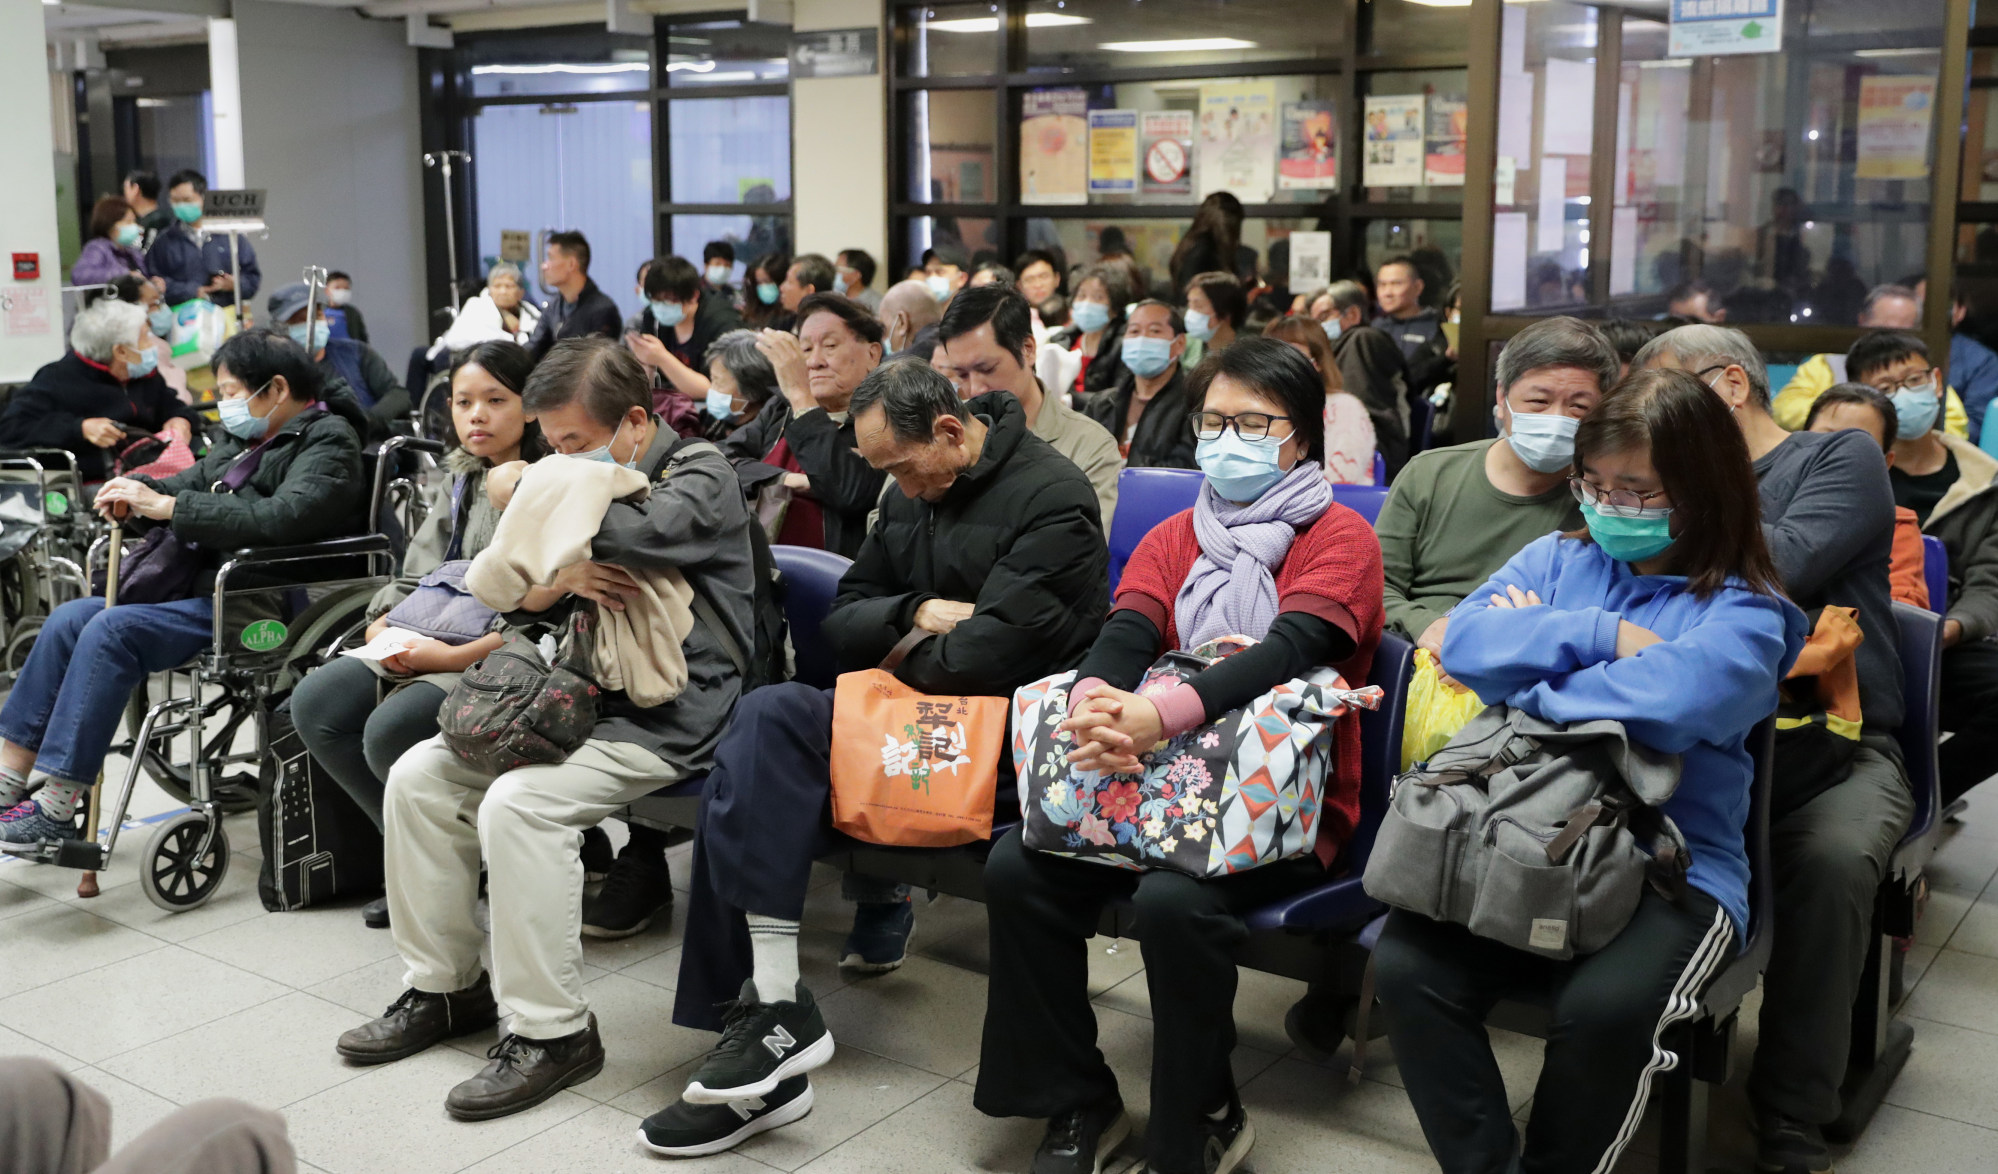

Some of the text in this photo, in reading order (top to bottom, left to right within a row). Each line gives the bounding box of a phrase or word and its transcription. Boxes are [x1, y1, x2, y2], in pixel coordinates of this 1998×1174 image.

[213, 193, 258, 207] UCH
[206, 207, 260, 217] PROPERTY
[246, 630, 283, 645] ALPHA
[957, 697, 968, 716] 台北
[762, 1024, 797, 1059] N
